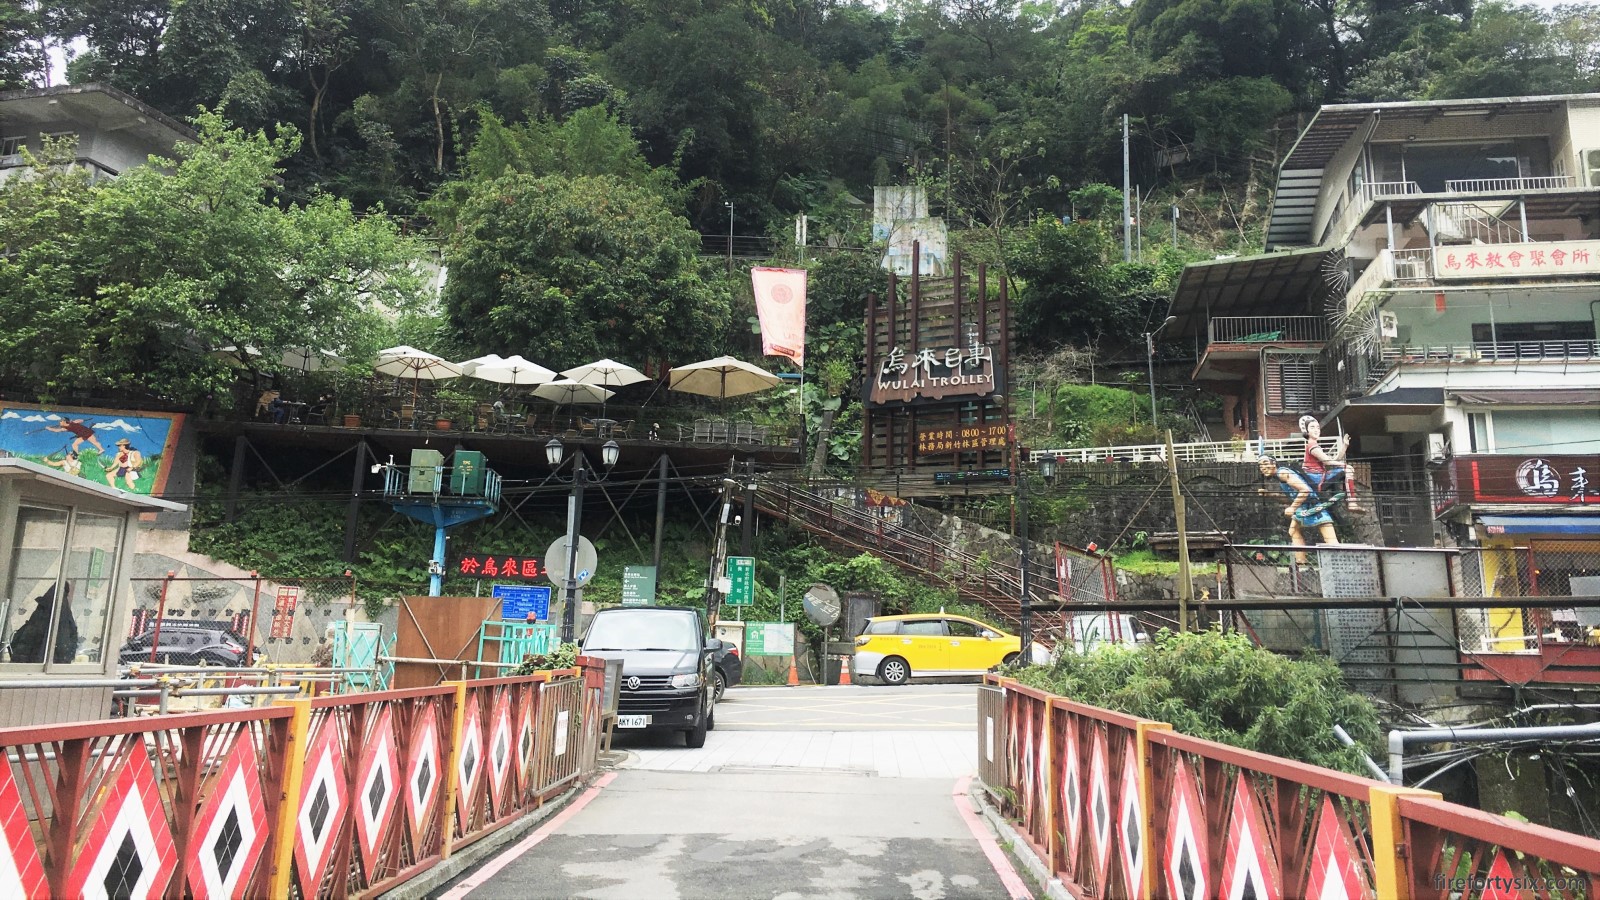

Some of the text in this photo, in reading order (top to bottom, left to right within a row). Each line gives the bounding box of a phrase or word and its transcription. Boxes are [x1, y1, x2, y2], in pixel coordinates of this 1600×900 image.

[1444, 248, 1590, 270] 烏來教會聚會所
[878, 374, 993, 391] WULAI TROLLEY
[460, 556, 549, 578] 於烏來區
